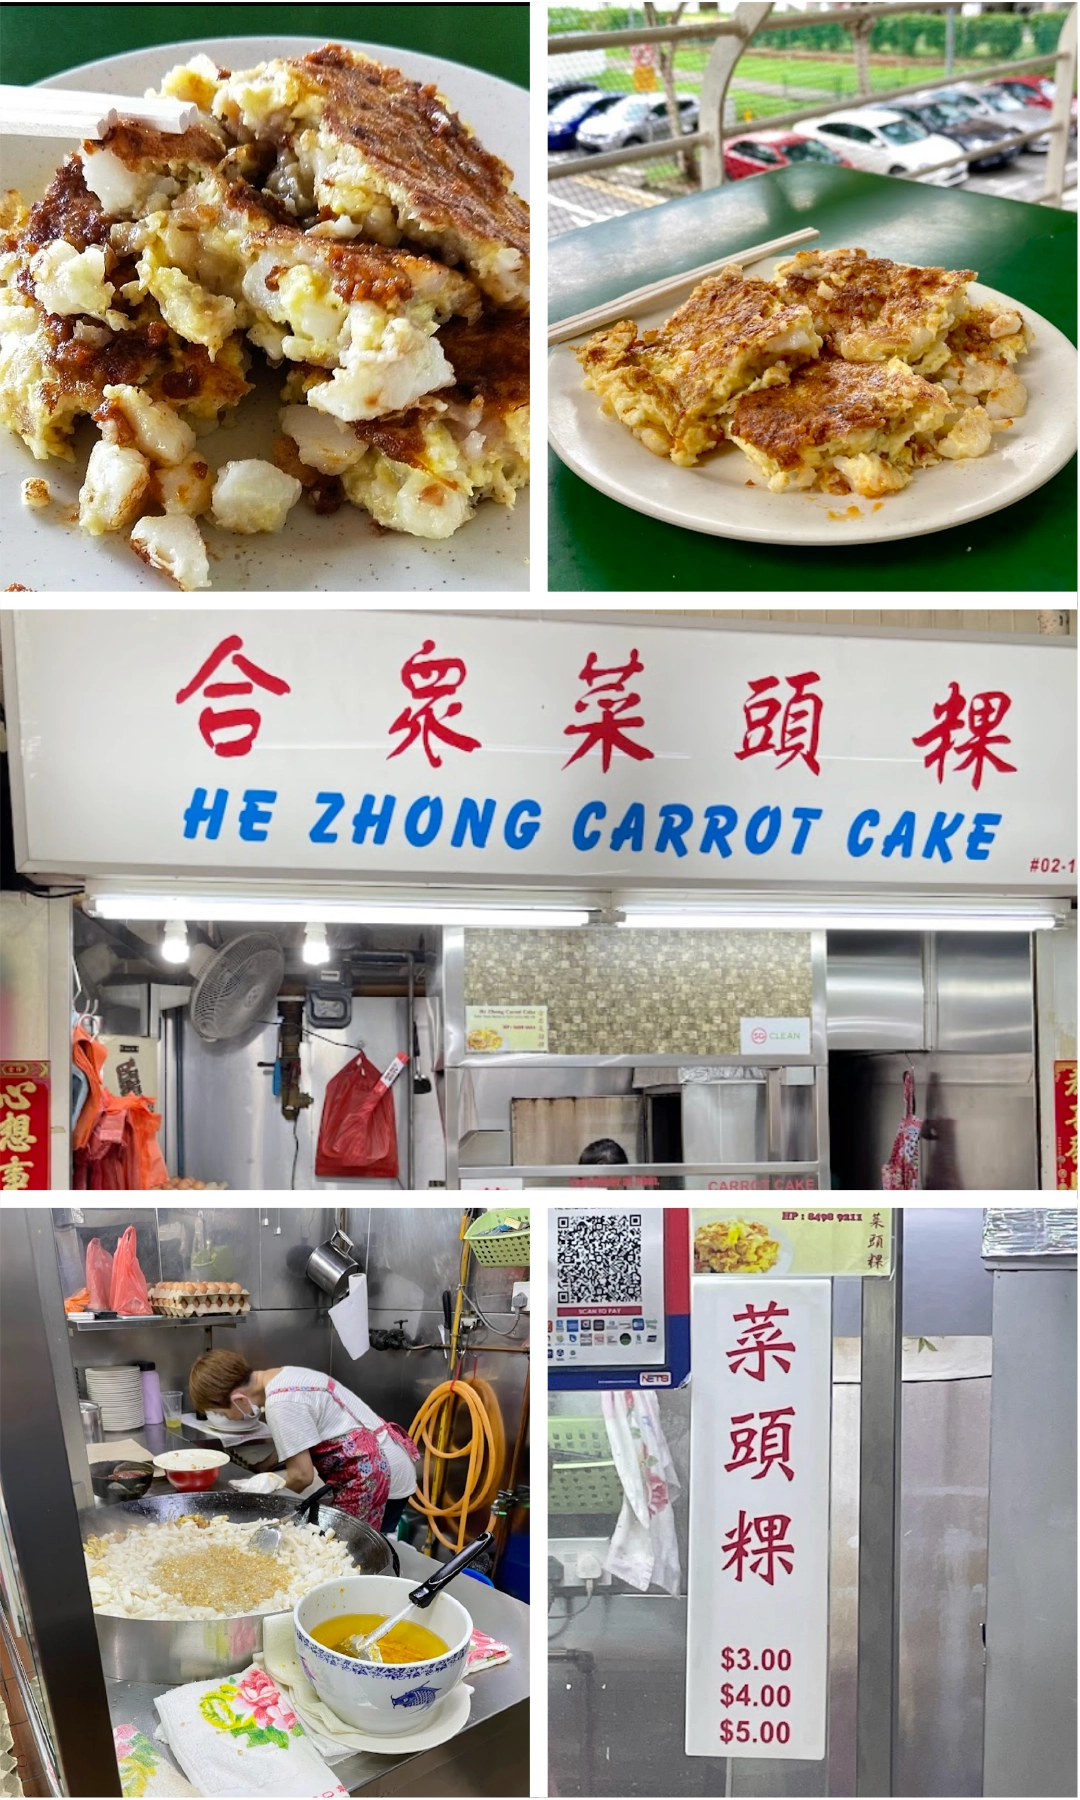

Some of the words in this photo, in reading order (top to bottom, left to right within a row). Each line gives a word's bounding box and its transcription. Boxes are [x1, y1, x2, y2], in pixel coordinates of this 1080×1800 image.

[183, 788, 278, 842] HE
[308, 792, 541, 851] ZHONG
[572, 801, 823, 859] CARROT
[846, 808, 1003, 863] CAKE
[1030, 858, 1075, 873] #02-1
[769, 1032, 801, 1040] CLEAN
[708, 1180, 770, 1190] CARROT
[774, 1178, 815, 1190] CAKE
[782, 1211, 799, 1220] HP
[867, 1212, 885, 1269] 菜頭粿
[641, 1374, 669, 1383] NETS
[722, 1301, 796, 1585] 菜頭粿
[720, 1647, 792, 1671] $3.00
[720, 1683, 792, 1707] $4.00
[720, 1719, 792, 1743] $5.00
